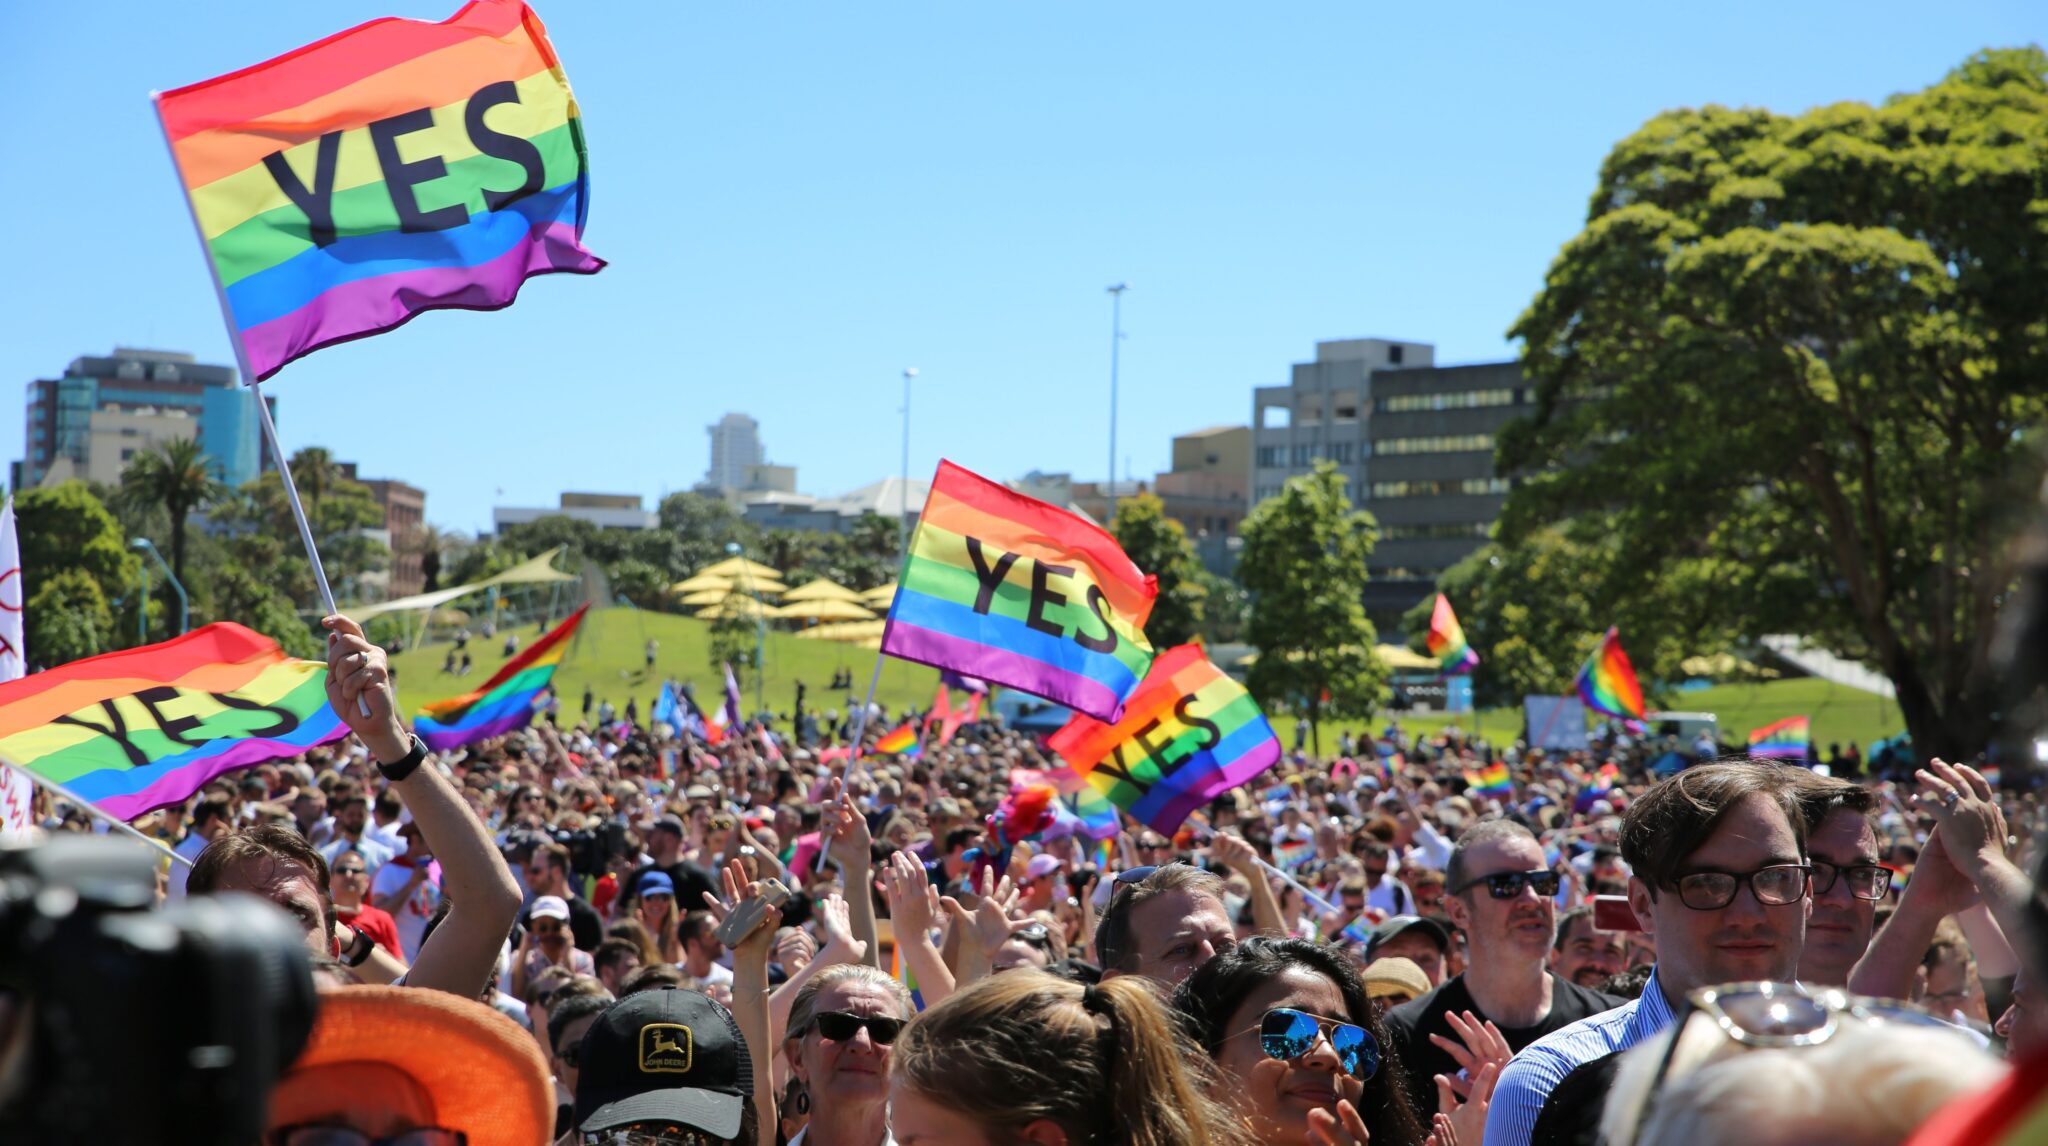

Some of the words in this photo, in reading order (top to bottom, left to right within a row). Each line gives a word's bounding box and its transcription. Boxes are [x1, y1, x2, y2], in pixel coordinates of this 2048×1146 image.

[261, 80, 545, 249] YES
[964, 535, 1119, 654] YES
[51, 686, 299, 767] YES
[1092, 693, 1221, 795] YES
[644, 1059, 663, 1067] JOHN
[664, 1059, 687, 1067] DEERE
